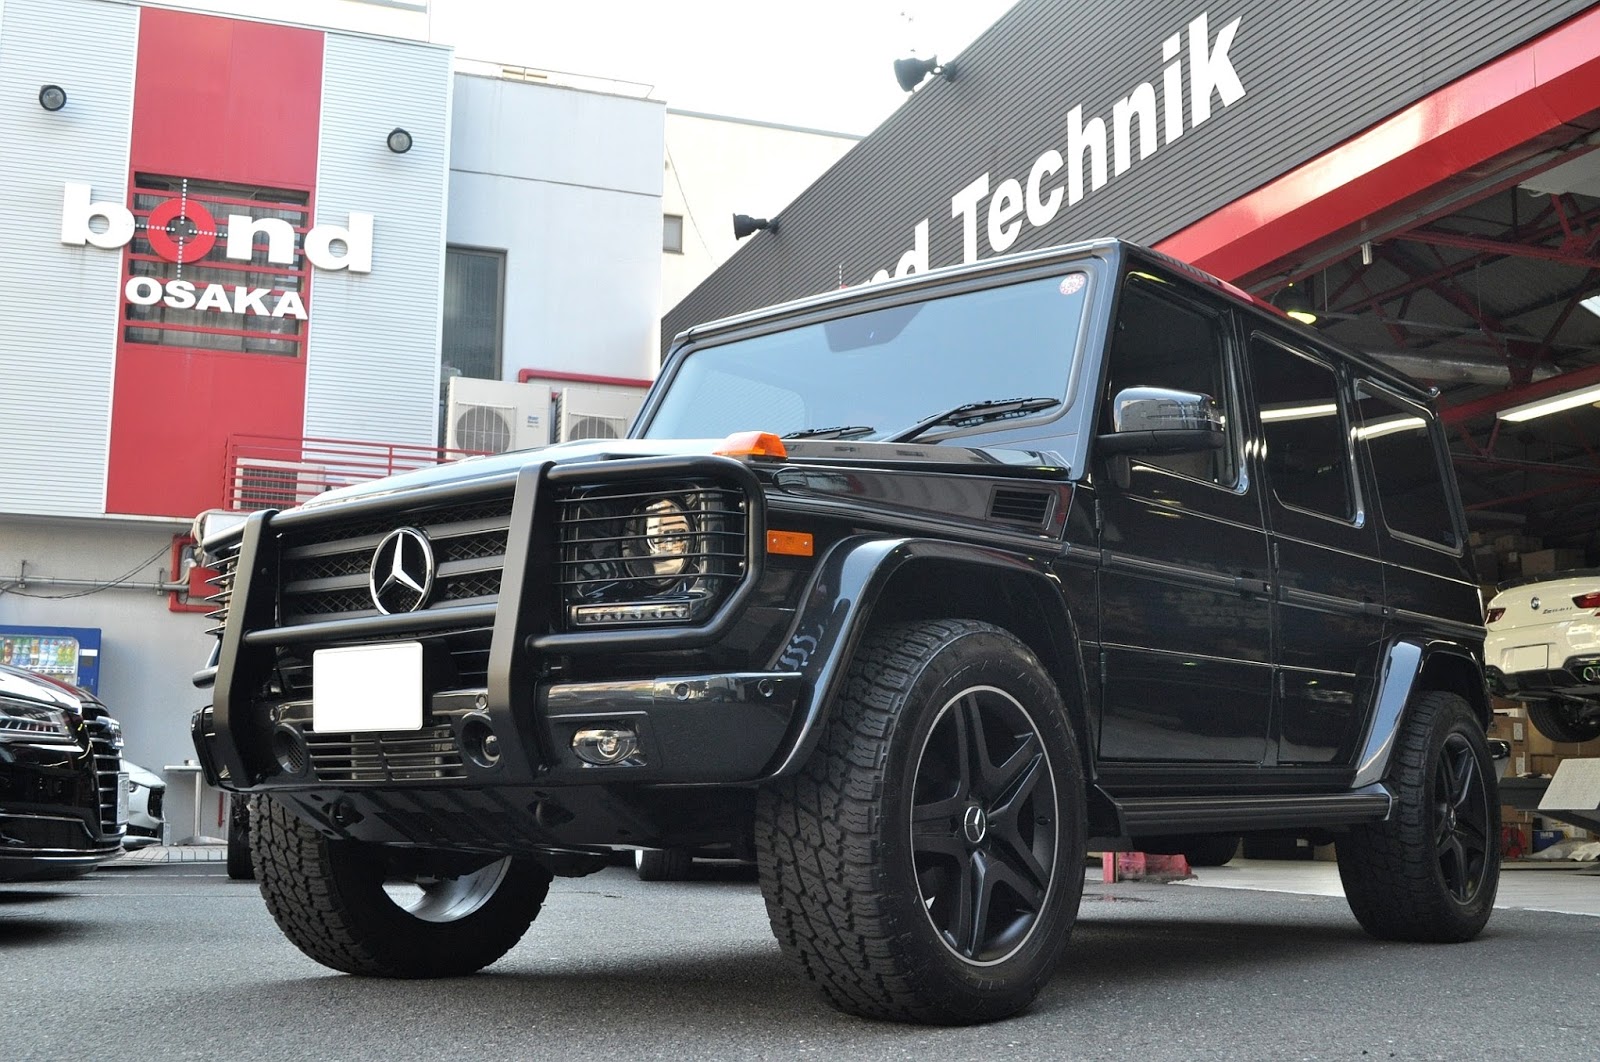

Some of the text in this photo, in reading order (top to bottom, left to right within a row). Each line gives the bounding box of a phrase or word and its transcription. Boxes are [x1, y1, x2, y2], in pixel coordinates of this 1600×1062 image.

[951, 12, 1246, 266] Technik
[61, 182, 374, 273] bond
[125, 276, 308, 320] OSAKA
